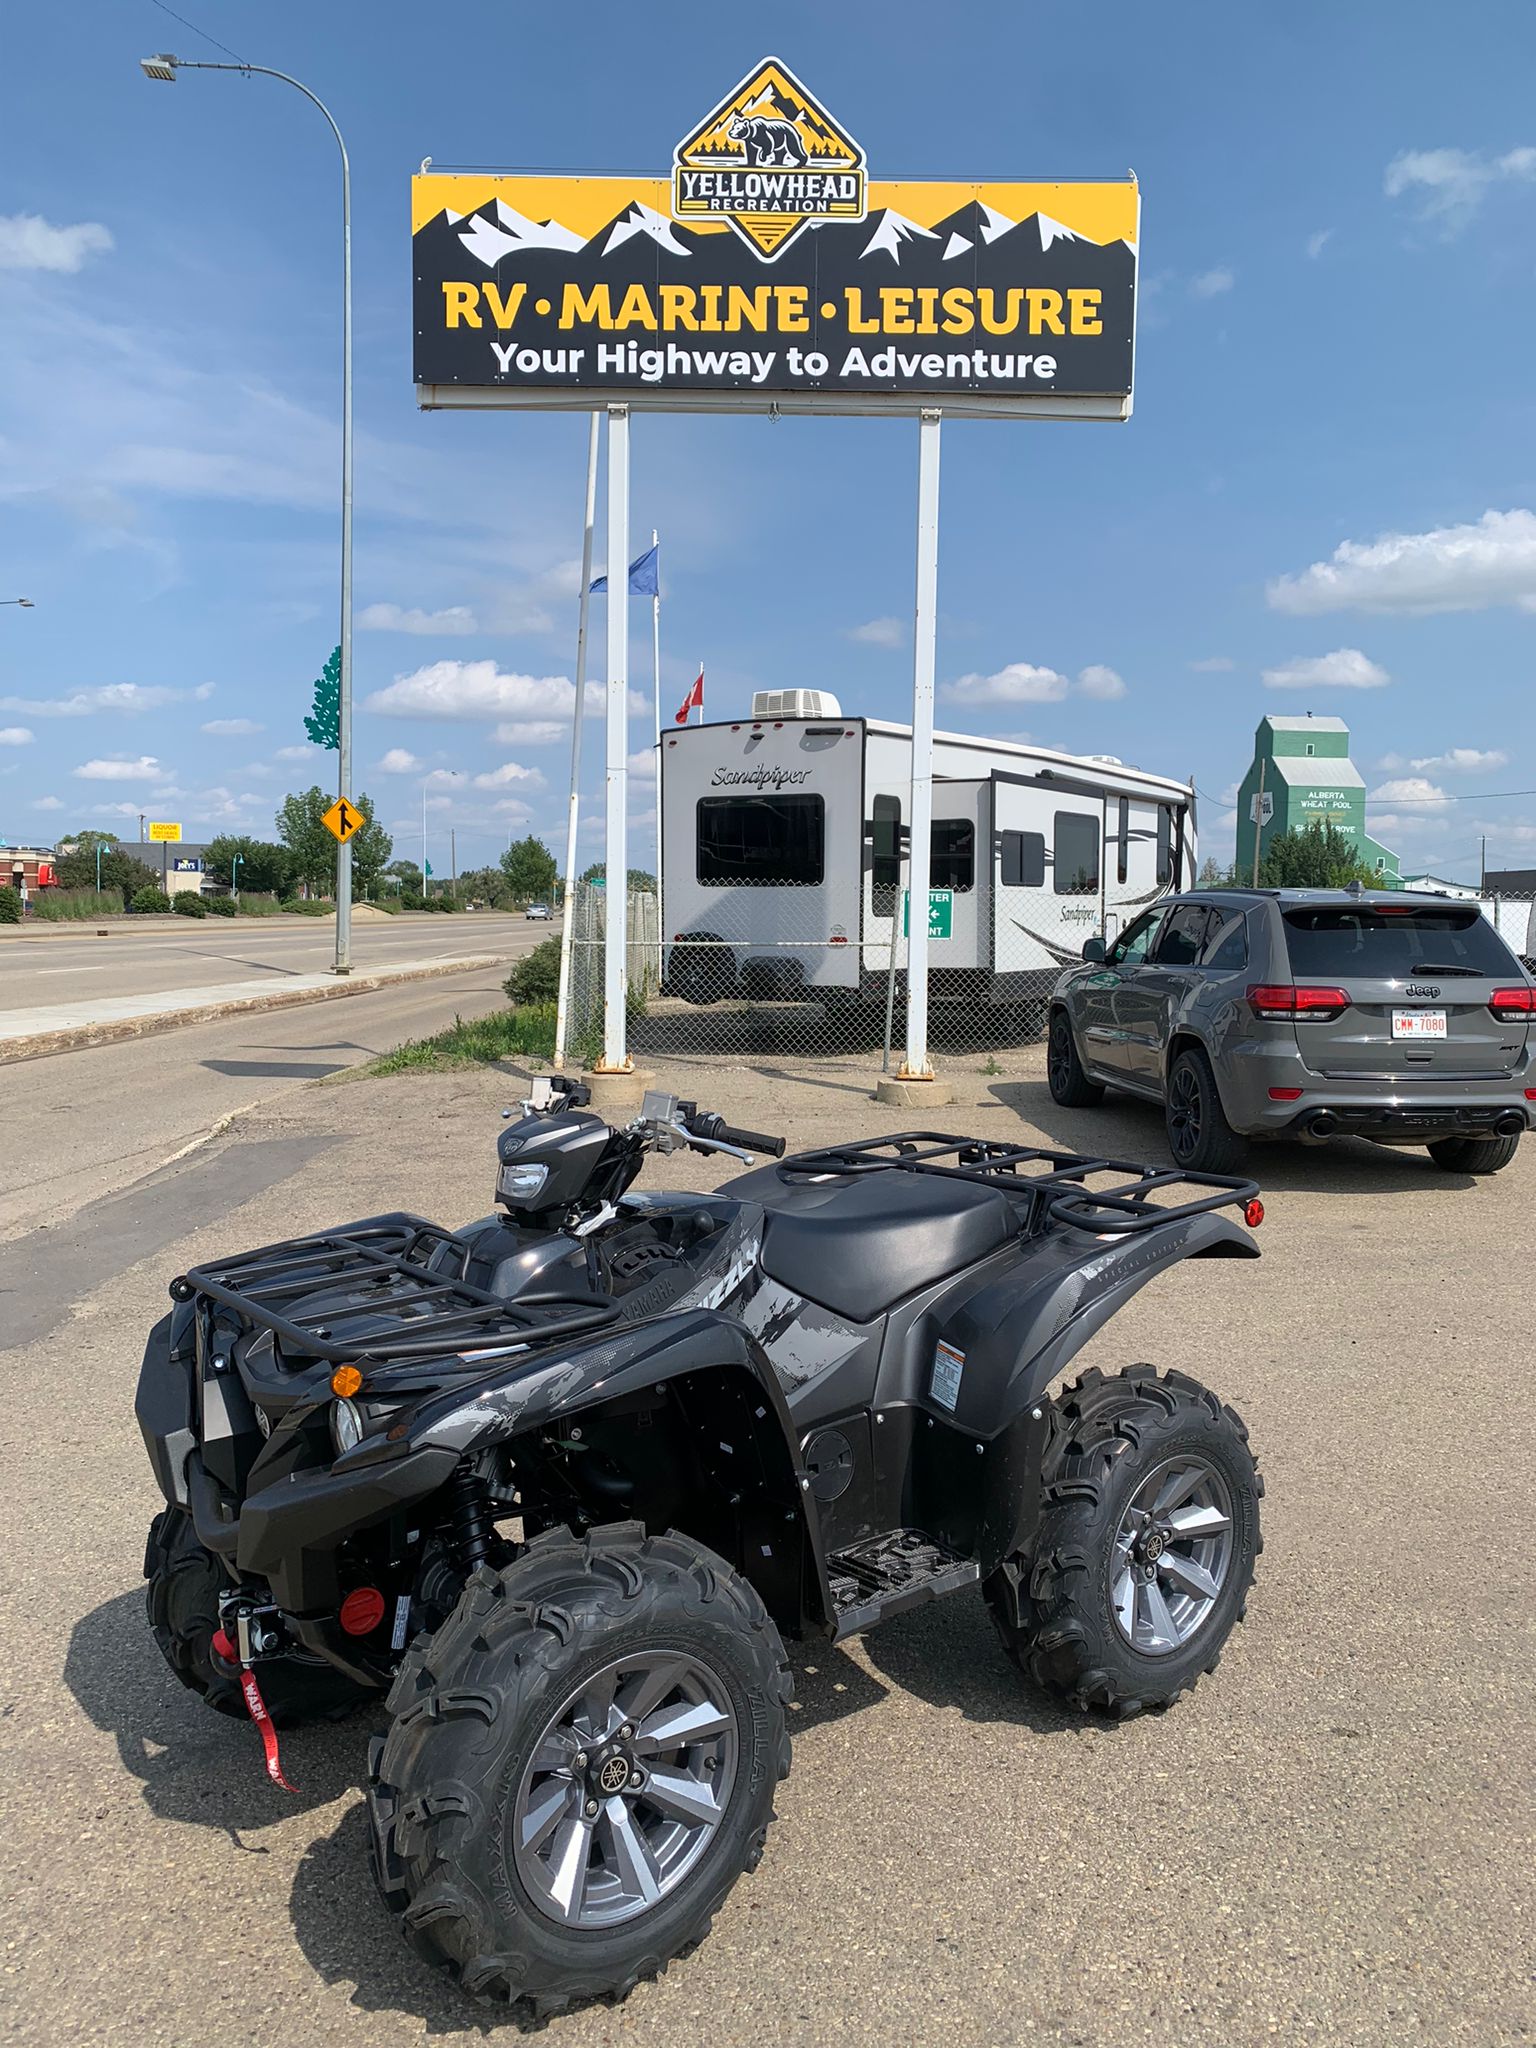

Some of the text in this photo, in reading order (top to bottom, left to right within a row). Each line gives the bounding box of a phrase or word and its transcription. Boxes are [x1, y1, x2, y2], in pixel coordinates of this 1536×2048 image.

[682, 172, 857, 200] YELLOWHEAD
[710, 199, 827, 213] RECREATION
[442, 281, 1103, 336] RV MARINE LEISURE
[489, 339, 1057, 383] Your Highway to Adventure
[711, 763, 813, 790] Sandpiper
[1300, 800, 1352, 809] WHEAT POOL
[1308, 791, 1345, 800] ALBERTA
[1406, 984, 1441, 999] Jeep
[621, 1278, 676, 1321] YAMAHA
[244, 1682, 267, 1721] WARN
